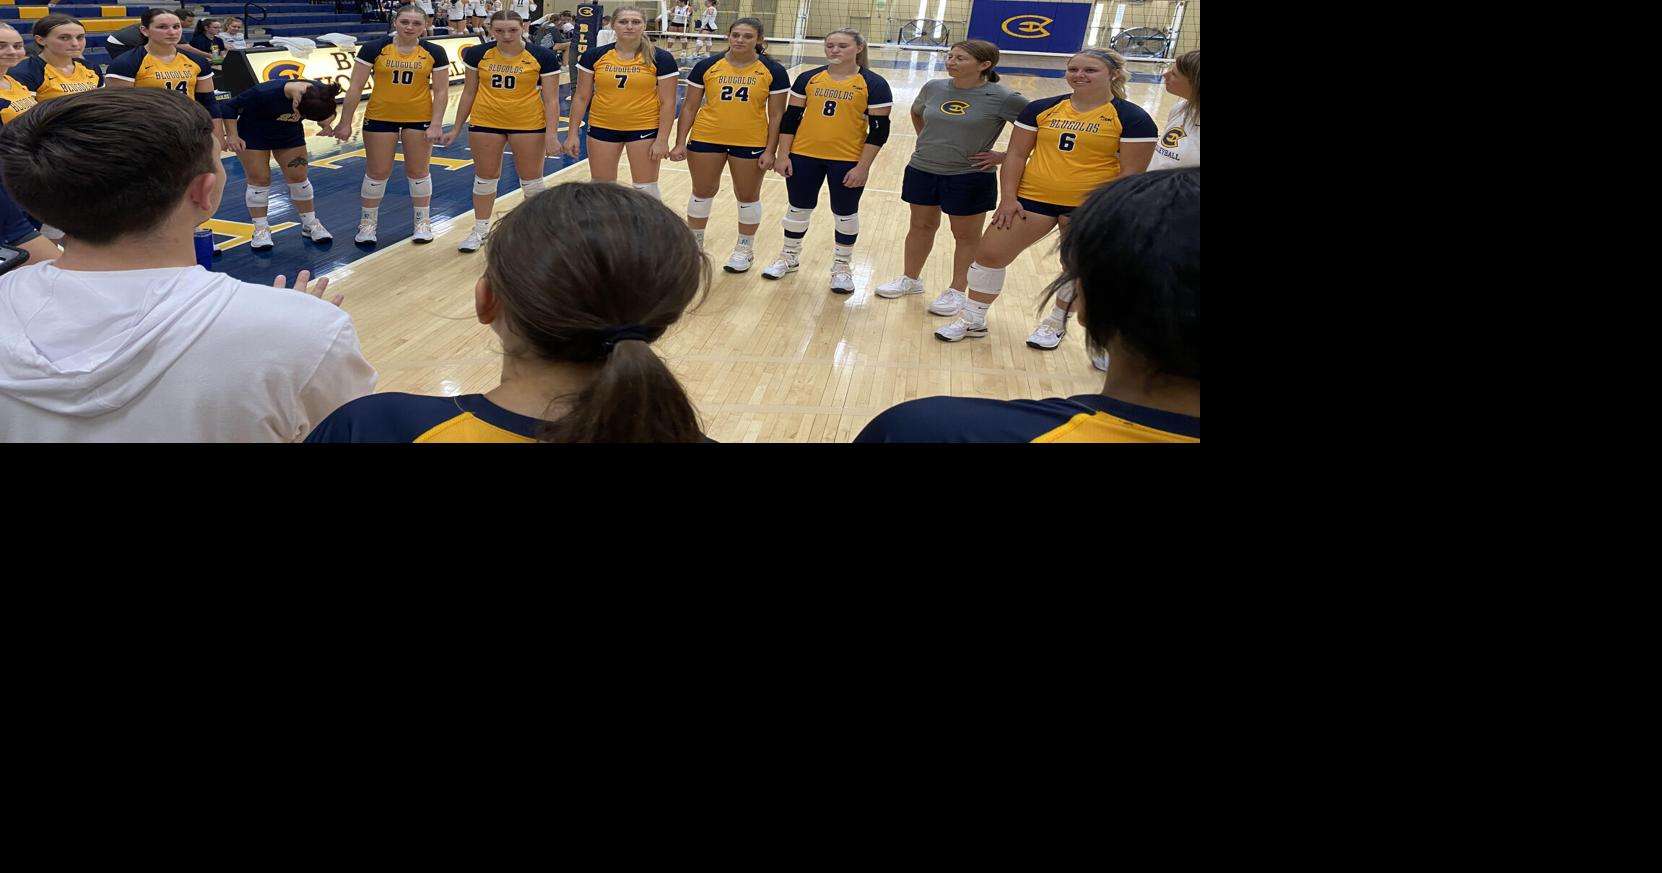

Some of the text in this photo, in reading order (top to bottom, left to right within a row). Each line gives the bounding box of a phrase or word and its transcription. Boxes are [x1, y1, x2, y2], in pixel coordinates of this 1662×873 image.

[392, 70, 414, 85] 10
[491, 73, 517, 90] 20
[614, 74, 628, 89] 7
[718, 75, 757, 86] BLUGOLDS
[720, 85, 750, 102] 24
[814, 87, 854, 101] BLUGOLDS
[822, 100, 837, 117] 8
[1049, 118, 1101, 134] BLUGOLDS
[1058, 132, 1078, 152] 6
